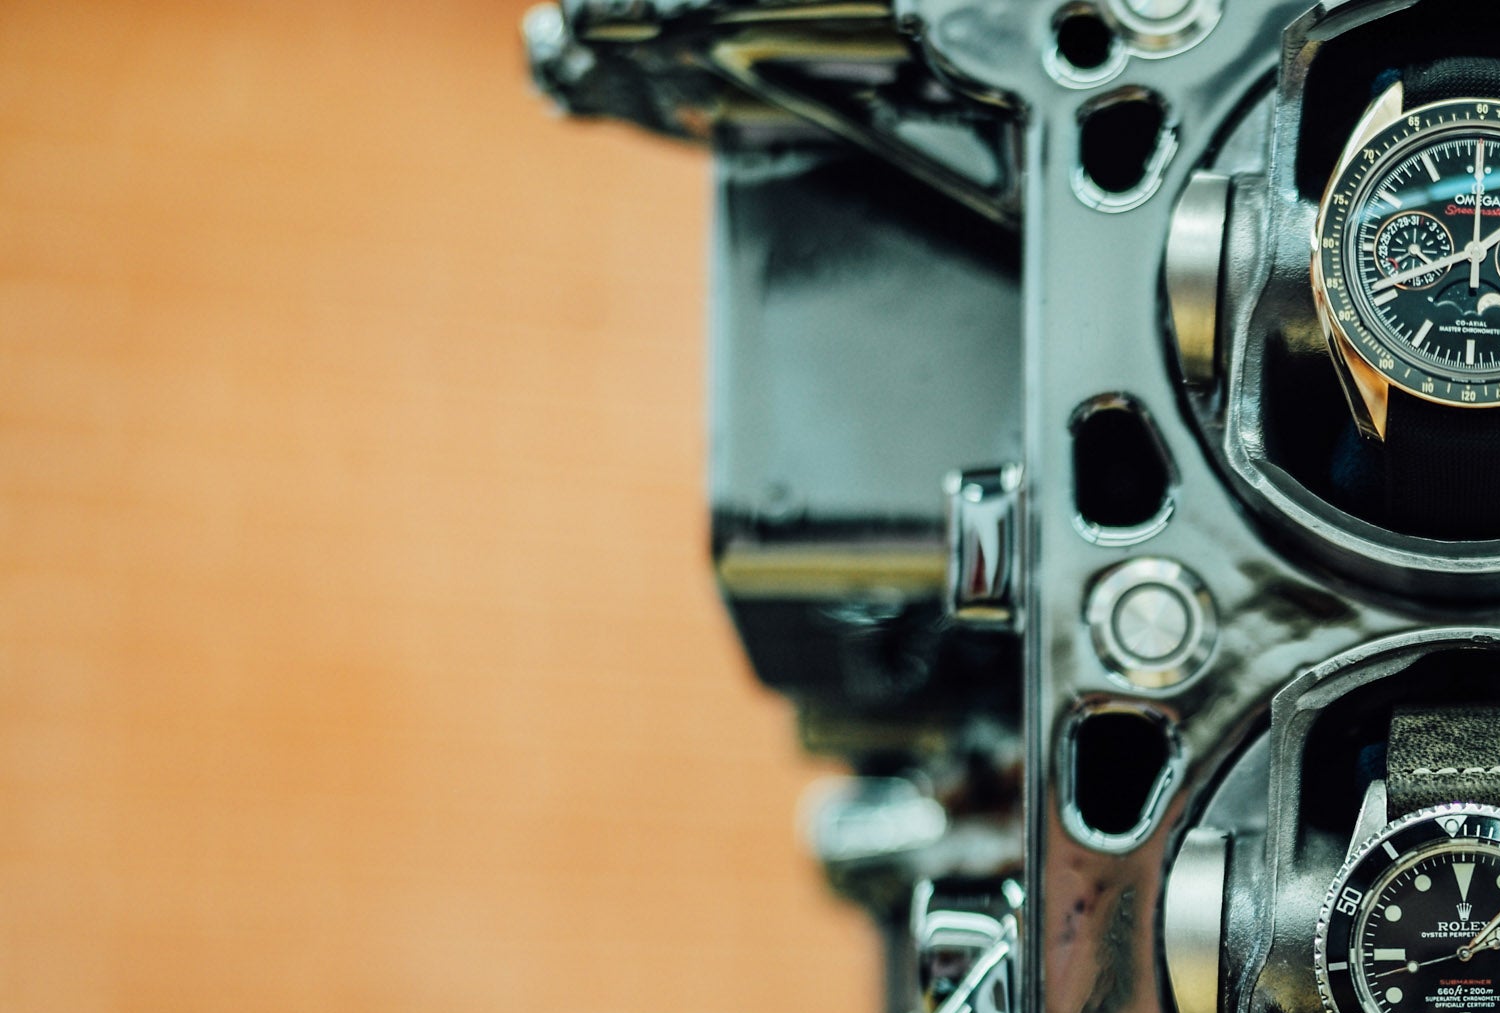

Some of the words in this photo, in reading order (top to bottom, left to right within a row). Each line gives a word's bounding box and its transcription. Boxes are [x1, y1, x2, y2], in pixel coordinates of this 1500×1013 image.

[1476, 104, 1488, 114] 60
[1408, 116, 1420, 127] 65
[1363, 149, 1375, 160] 70
[1333, 194, 1345, 205] 75
[1322, 238, 1334, 249] 80
[1326, 278, 1339, 289] 85
[1338, 310, 1350, 321] 90
[1379, 359, 1395, 370] 100
[1422, 383, 1434, 393] 110
[1461, 391, 1476, 401] 120
[1336, 886, 1363, 916] 50
[1469, 987, 1494, 995] 200m
